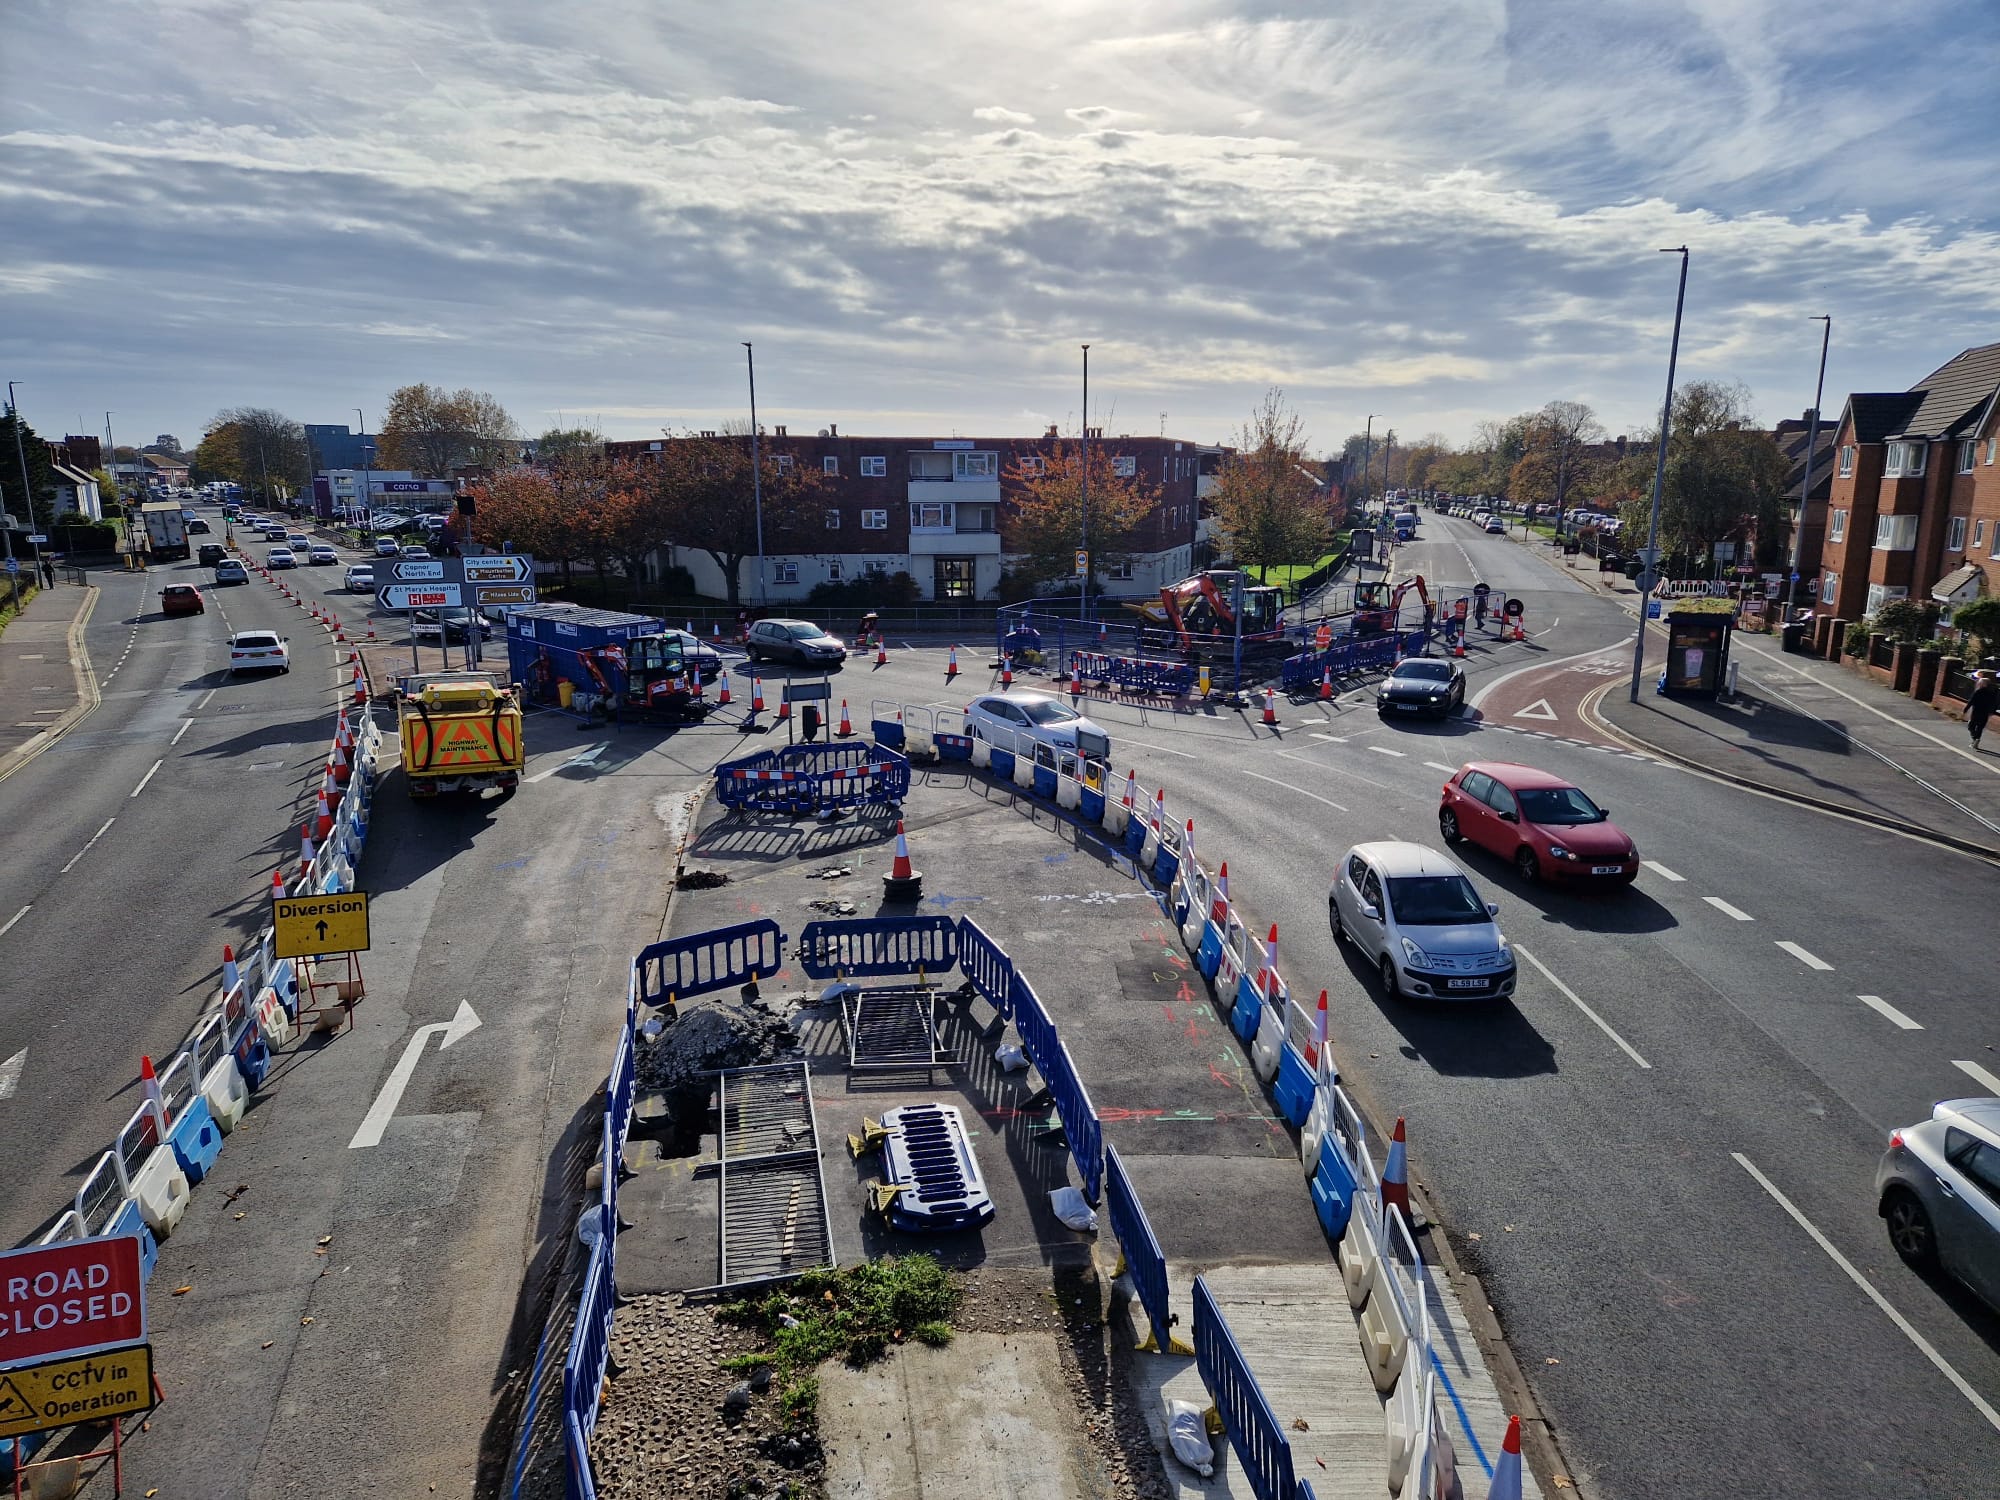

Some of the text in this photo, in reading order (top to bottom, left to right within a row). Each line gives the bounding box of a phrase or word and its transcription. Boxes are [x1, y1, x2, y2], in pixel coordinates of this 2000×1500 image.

[411, 594, 420, 605] H
[440, 744, 488, 752] MAINTENANCE
[279, 900, 362, 918] Diversion
[8, 1263, 110, 1303] ROAD
[52, 1364, 128, 1391] CCTV in
[44, 1389, 137, 1418] Operation
